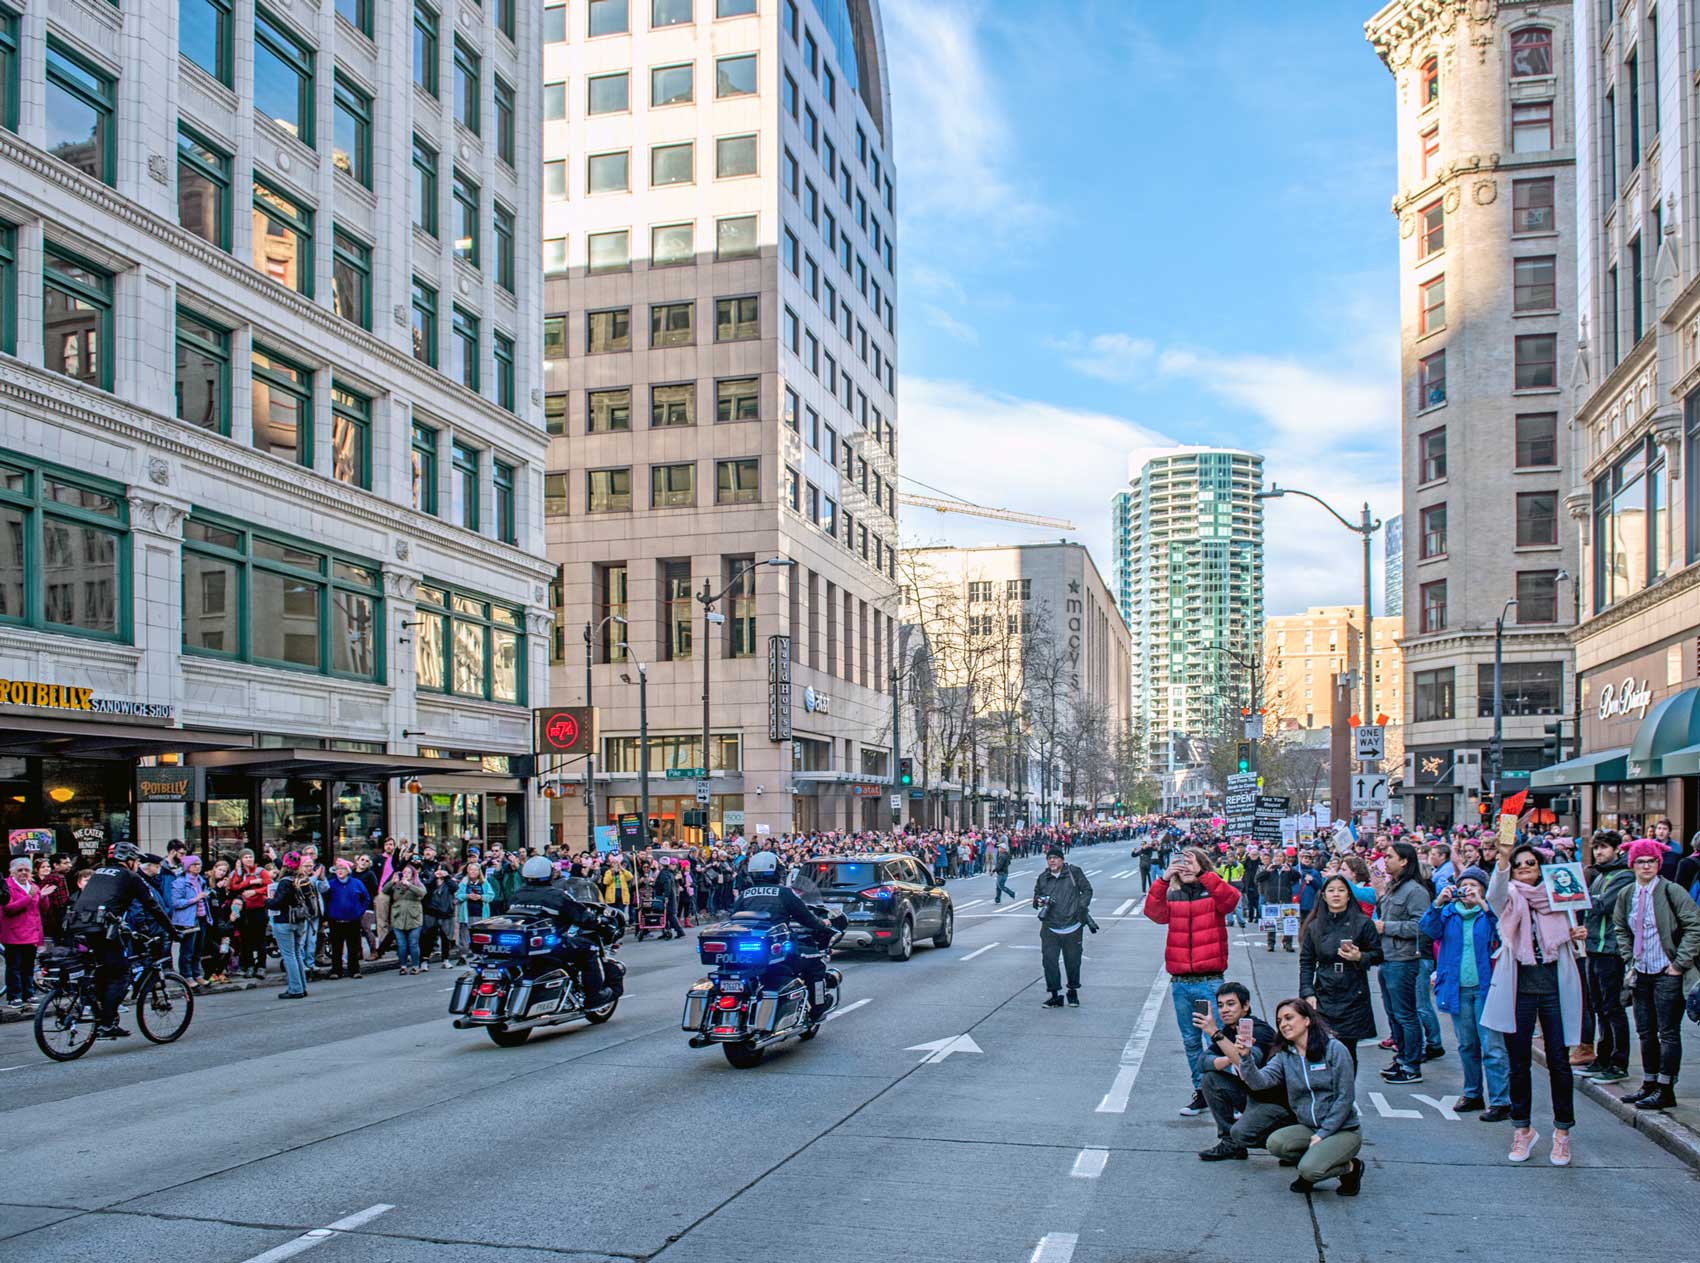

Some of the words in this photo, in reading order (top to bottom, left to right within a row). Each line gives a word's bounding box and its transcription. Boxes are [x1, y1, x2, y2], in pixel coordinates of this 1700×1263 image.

[0, 679, 93, 711] POTBELLY
[92, 699, 149, 716] SANDWICH
[1360, 729, 1379, 737] ONE
[1360, 738, 1380, 746] WAY
[1226, 794, 1255, 804] REPENT
[73, 829, 83, 839] WE
[84, 828, 104, 839] CATER
[744, 887, 777, 898] POLICE
[483, 945, 512, 954] POLICE
[715, 953, 752, 964] POLICE
